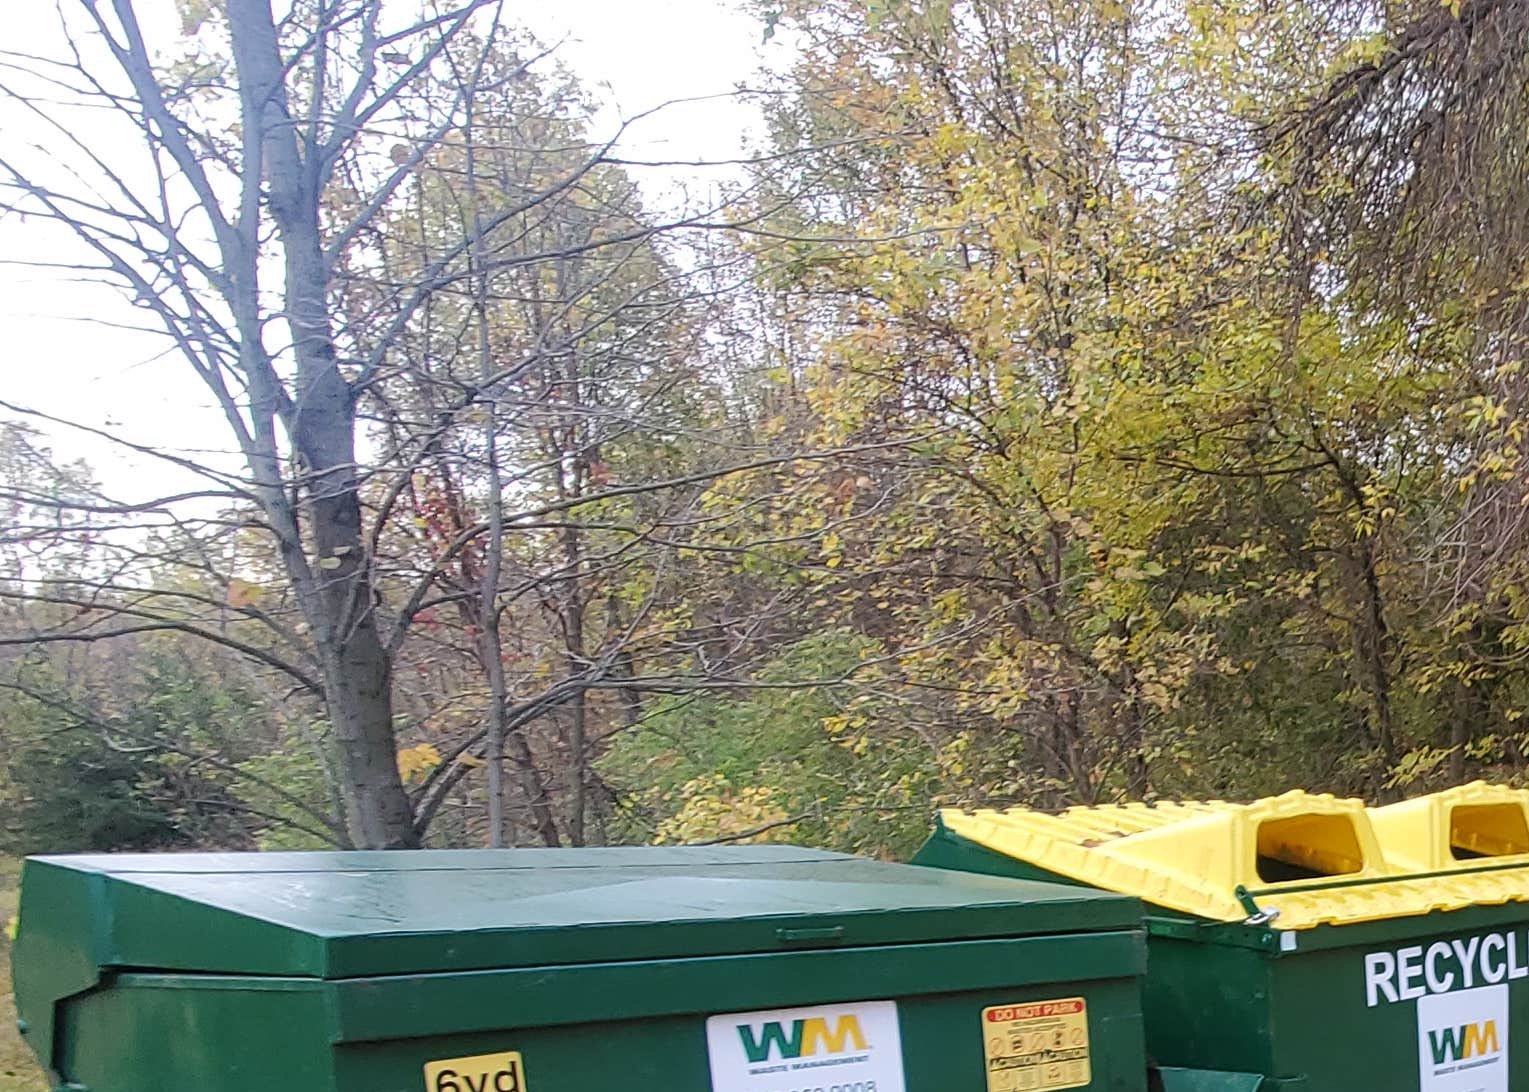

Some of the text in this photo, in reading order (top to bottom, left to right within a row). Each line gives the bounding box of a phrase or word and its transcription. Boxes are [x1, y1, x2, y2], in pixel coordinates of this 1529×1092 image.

[994, 1009, 1015, 1022] DO
[1015, 1006, 1042, 1019] NOT
[1042, 1001, 1077, 1015] PARK
[736, 1014, 869, 1063] WM
[1427, 1018, 1499, 1065] WM
[749, 1055, 870, 1075] WASTE MANAGEMENT
